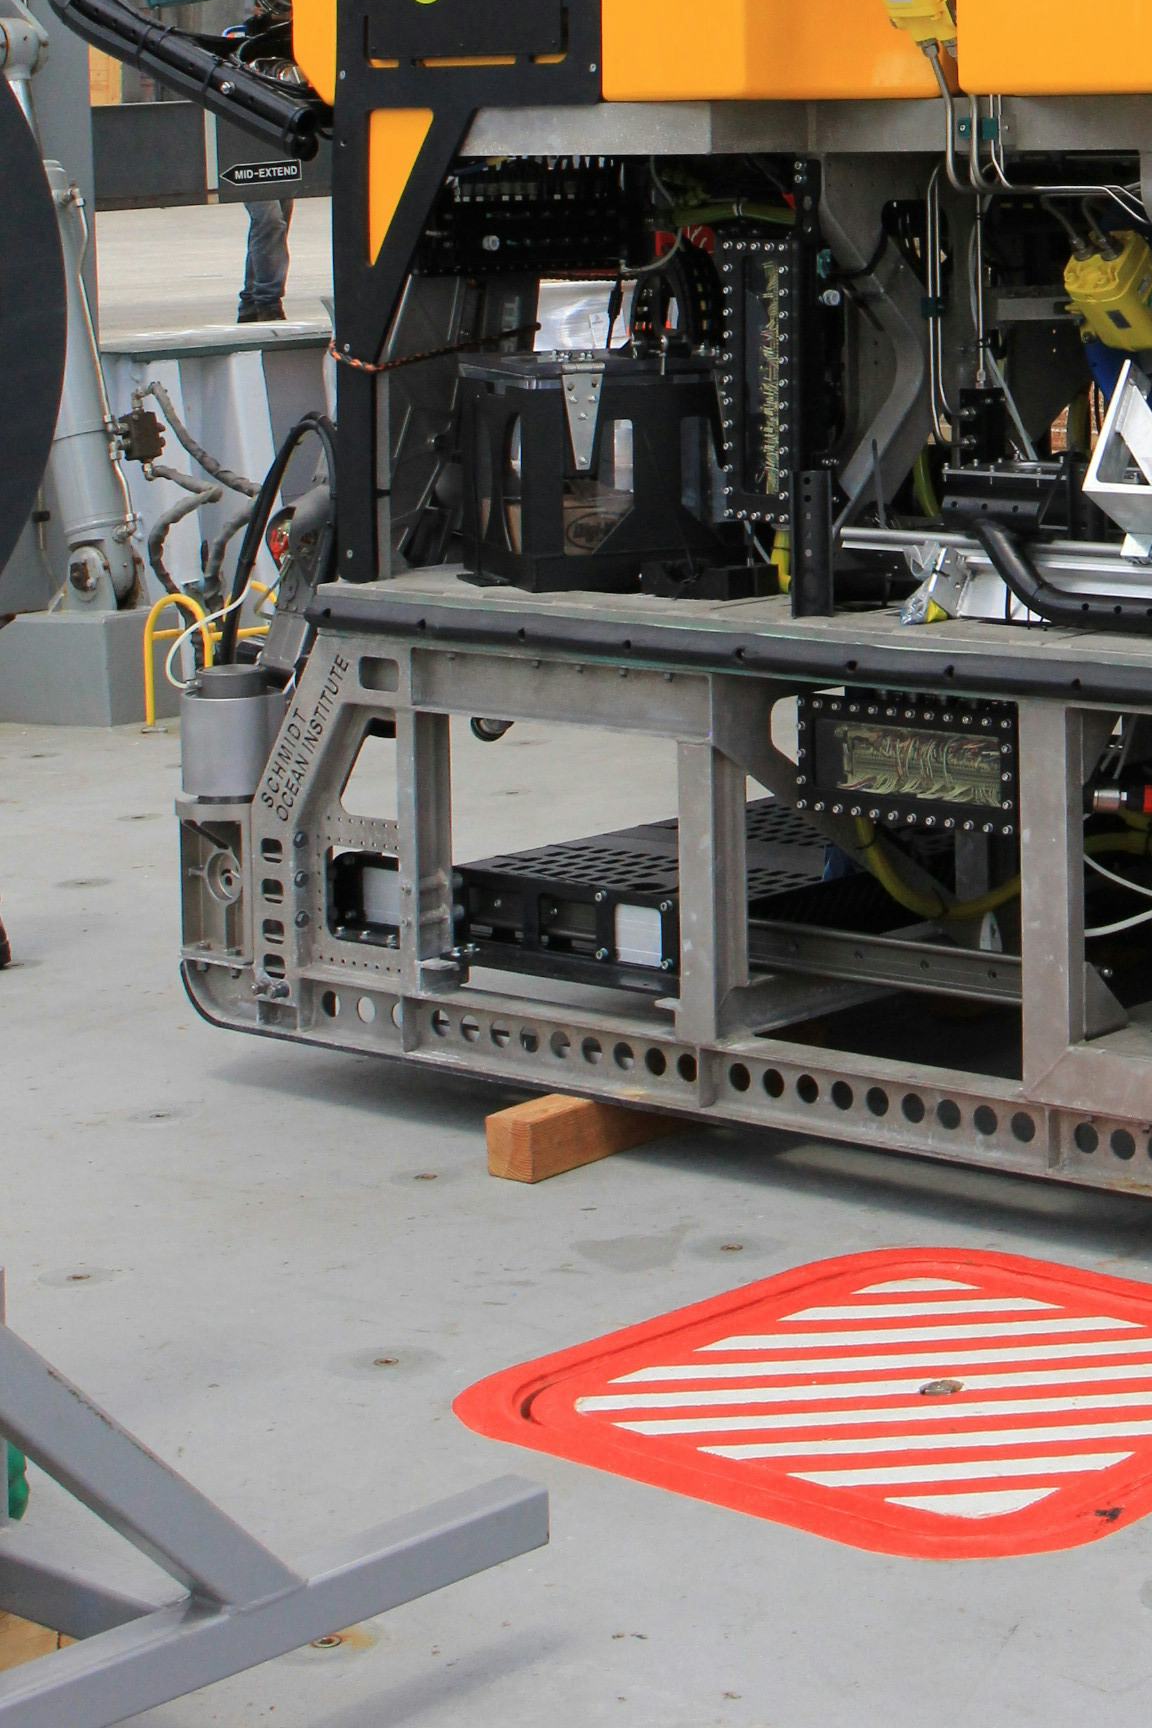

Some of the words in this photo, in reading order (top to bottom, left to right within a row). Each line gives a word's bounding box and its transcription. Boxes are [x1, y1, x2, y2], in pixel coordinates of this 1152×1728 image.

[235, 166, 298, 180] MID-EXTEND
[261, 707, 307, 809] SCHMIDT
[275, 754, 310, 823] OCEAN
[302, 654, 350, 756] INSTITUTE
